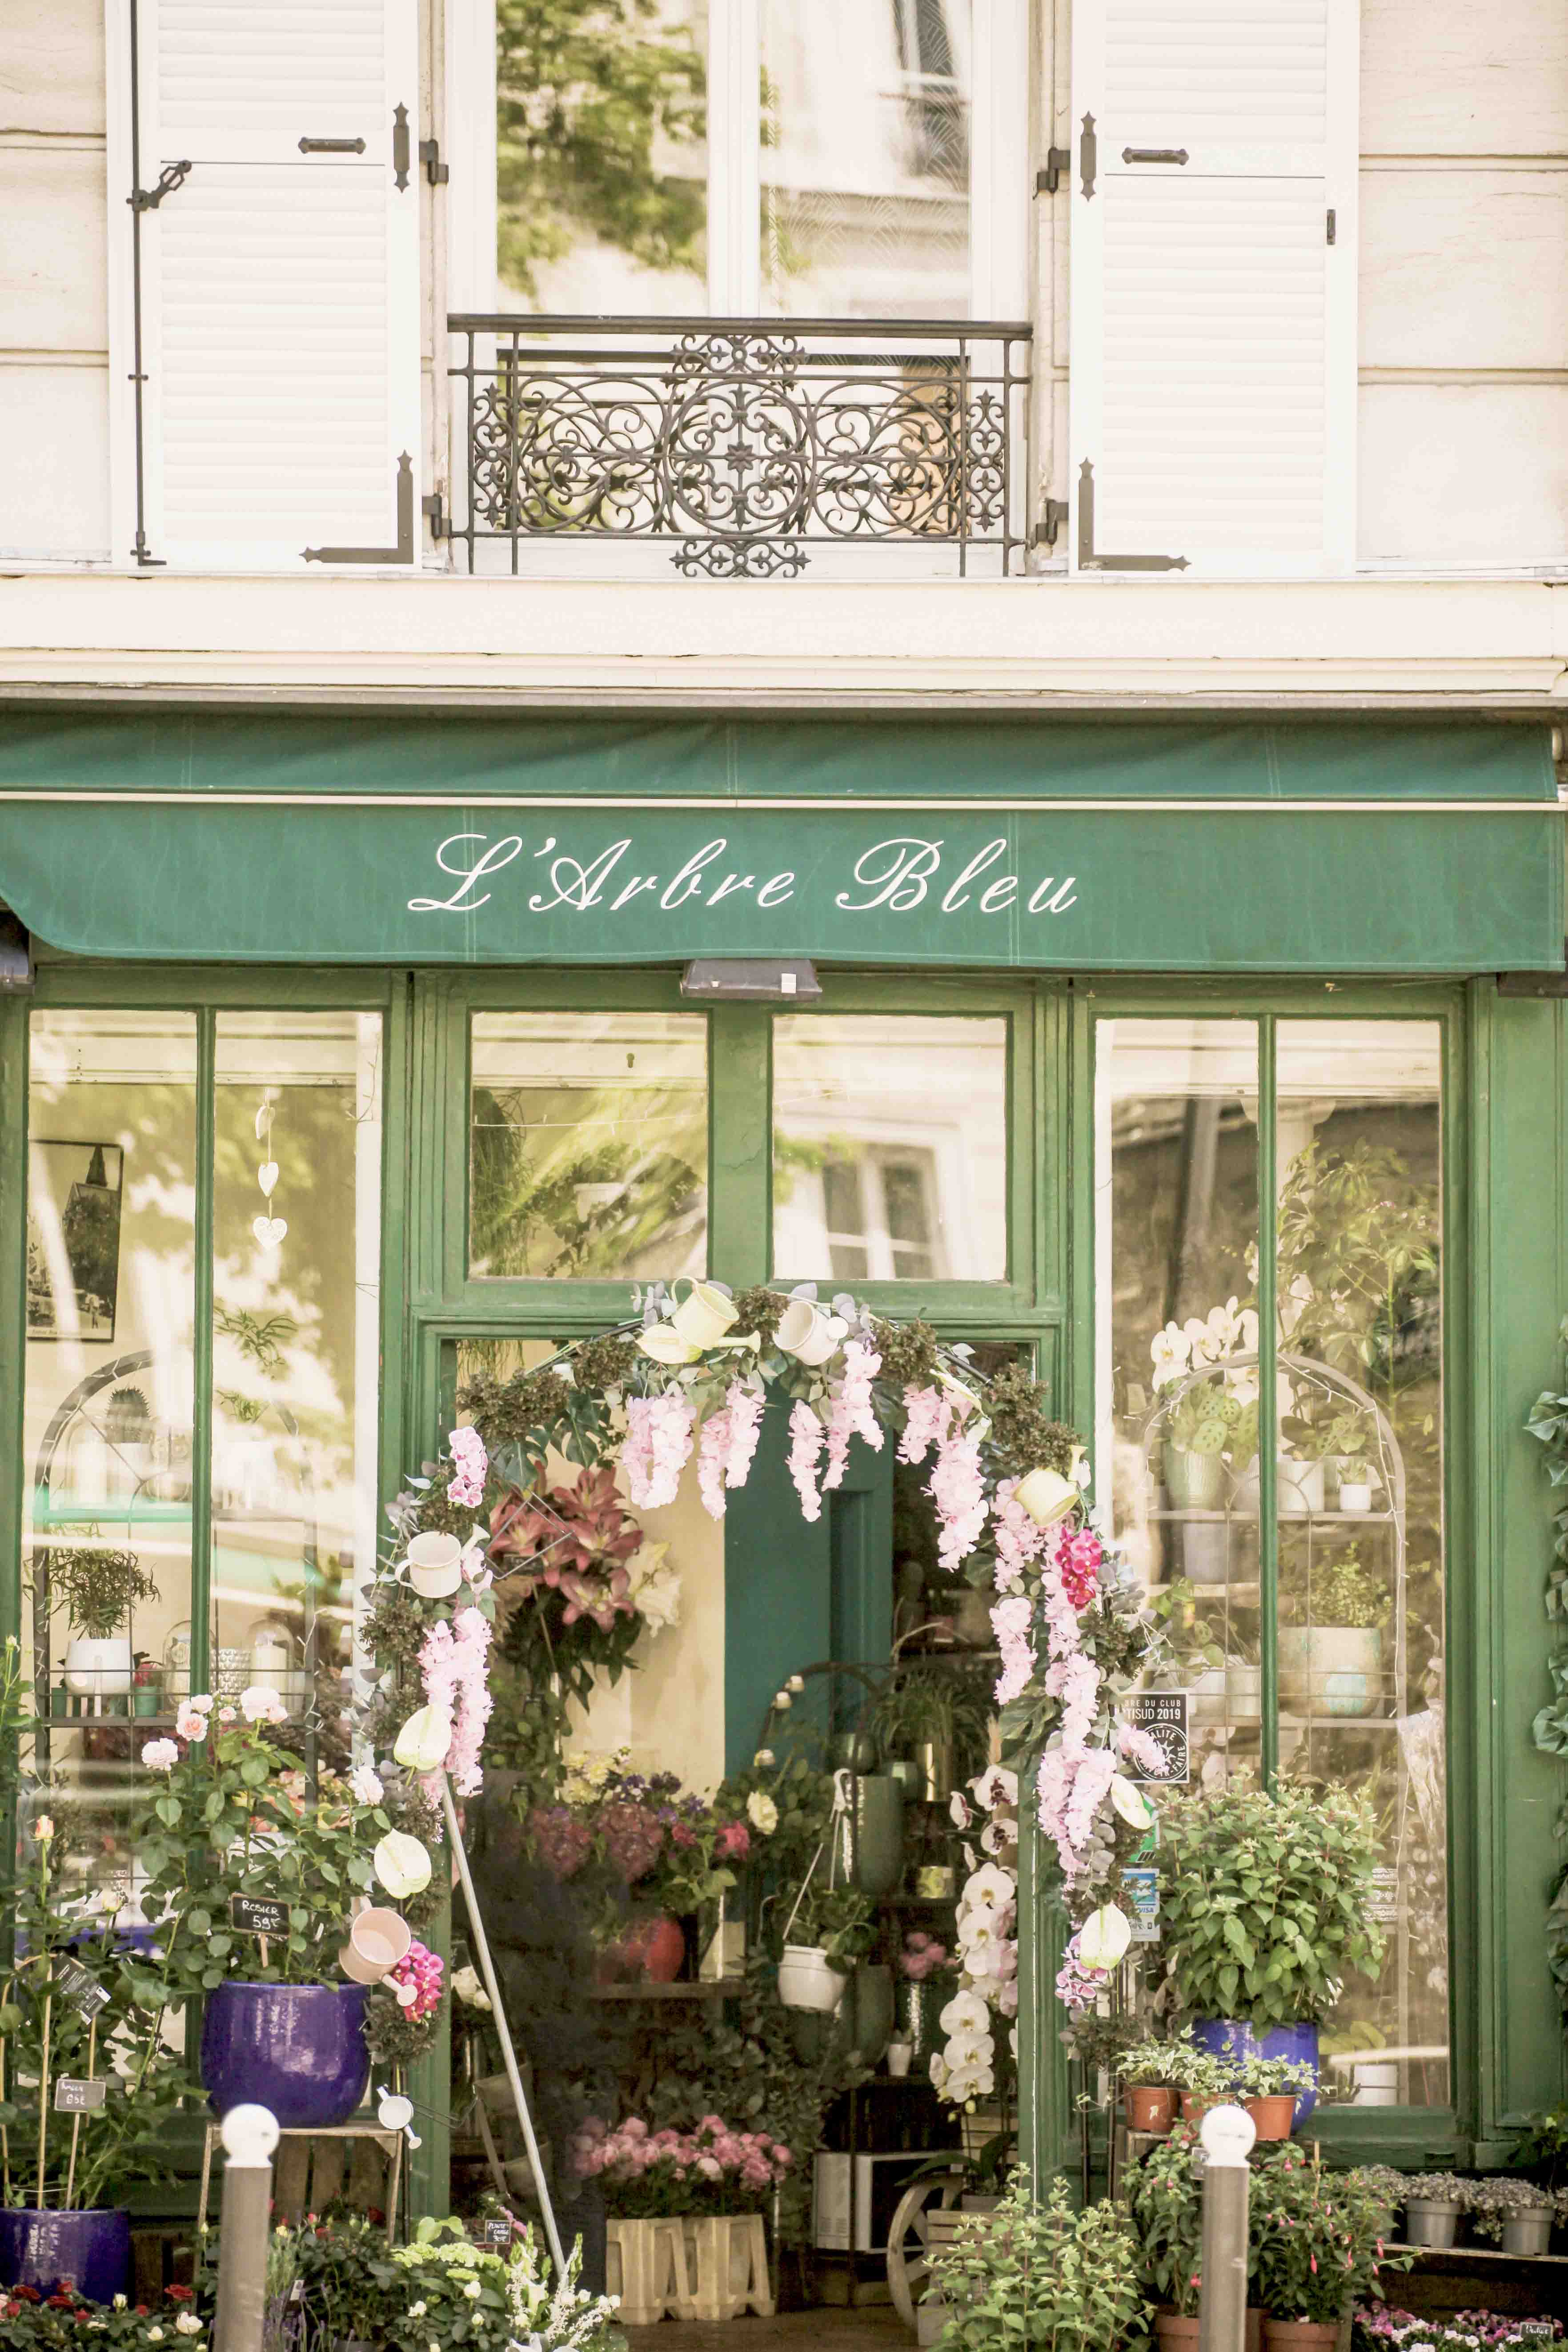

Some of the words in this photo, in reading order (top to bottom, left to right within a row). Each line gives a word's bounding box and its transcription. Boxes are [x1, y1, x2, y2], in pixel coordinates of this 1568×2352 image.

[407, 834, 795, 912] L'Arbre
[834, 838, 1078, 913] Bleu
[1157, 1708, 1181, 1720] 2019
